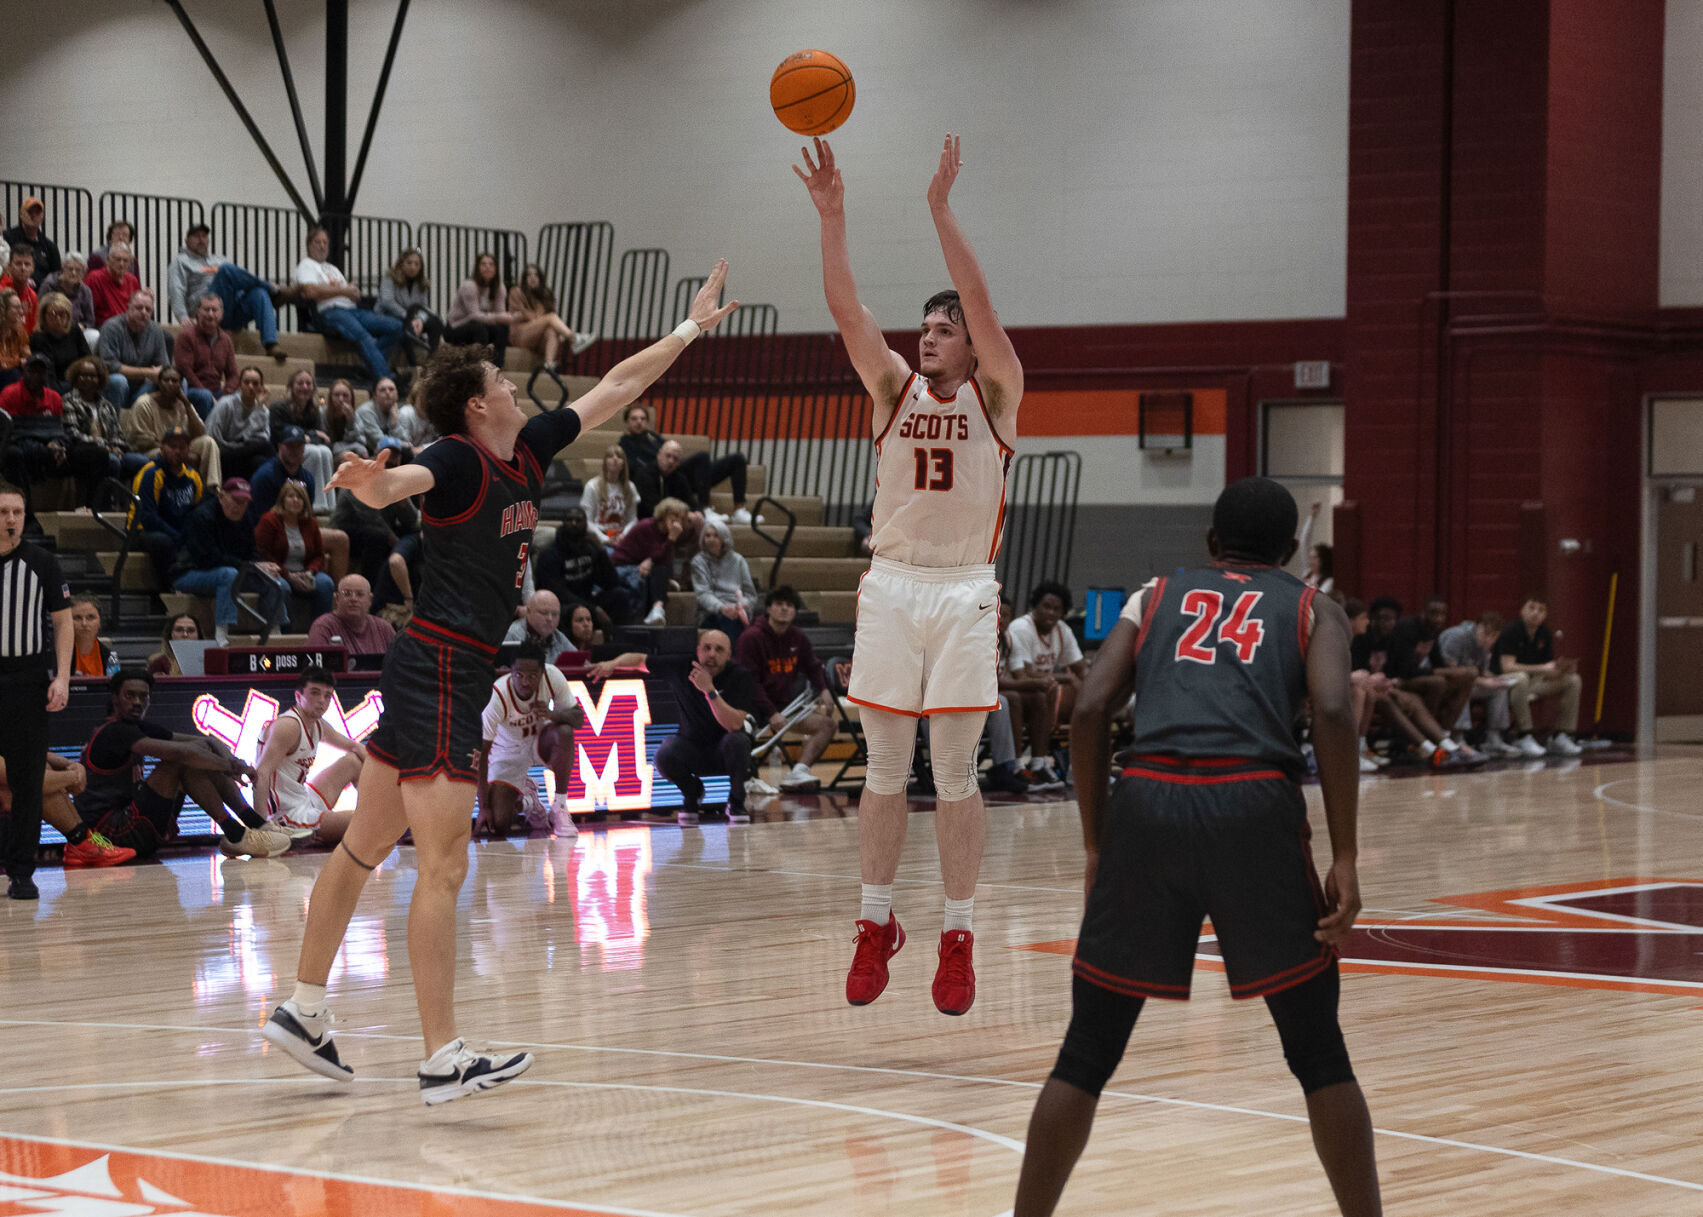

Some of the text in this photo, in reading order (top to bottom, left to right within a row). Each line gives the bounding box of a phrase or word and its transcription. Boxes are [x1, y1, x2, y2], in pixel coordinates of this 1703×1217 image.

[900, 412, 969, 440] SCOTS
[914, 447, 954, 492] 13
[1175, 588, 1265, 664] 24
[275, 655, 298, 671] poss
